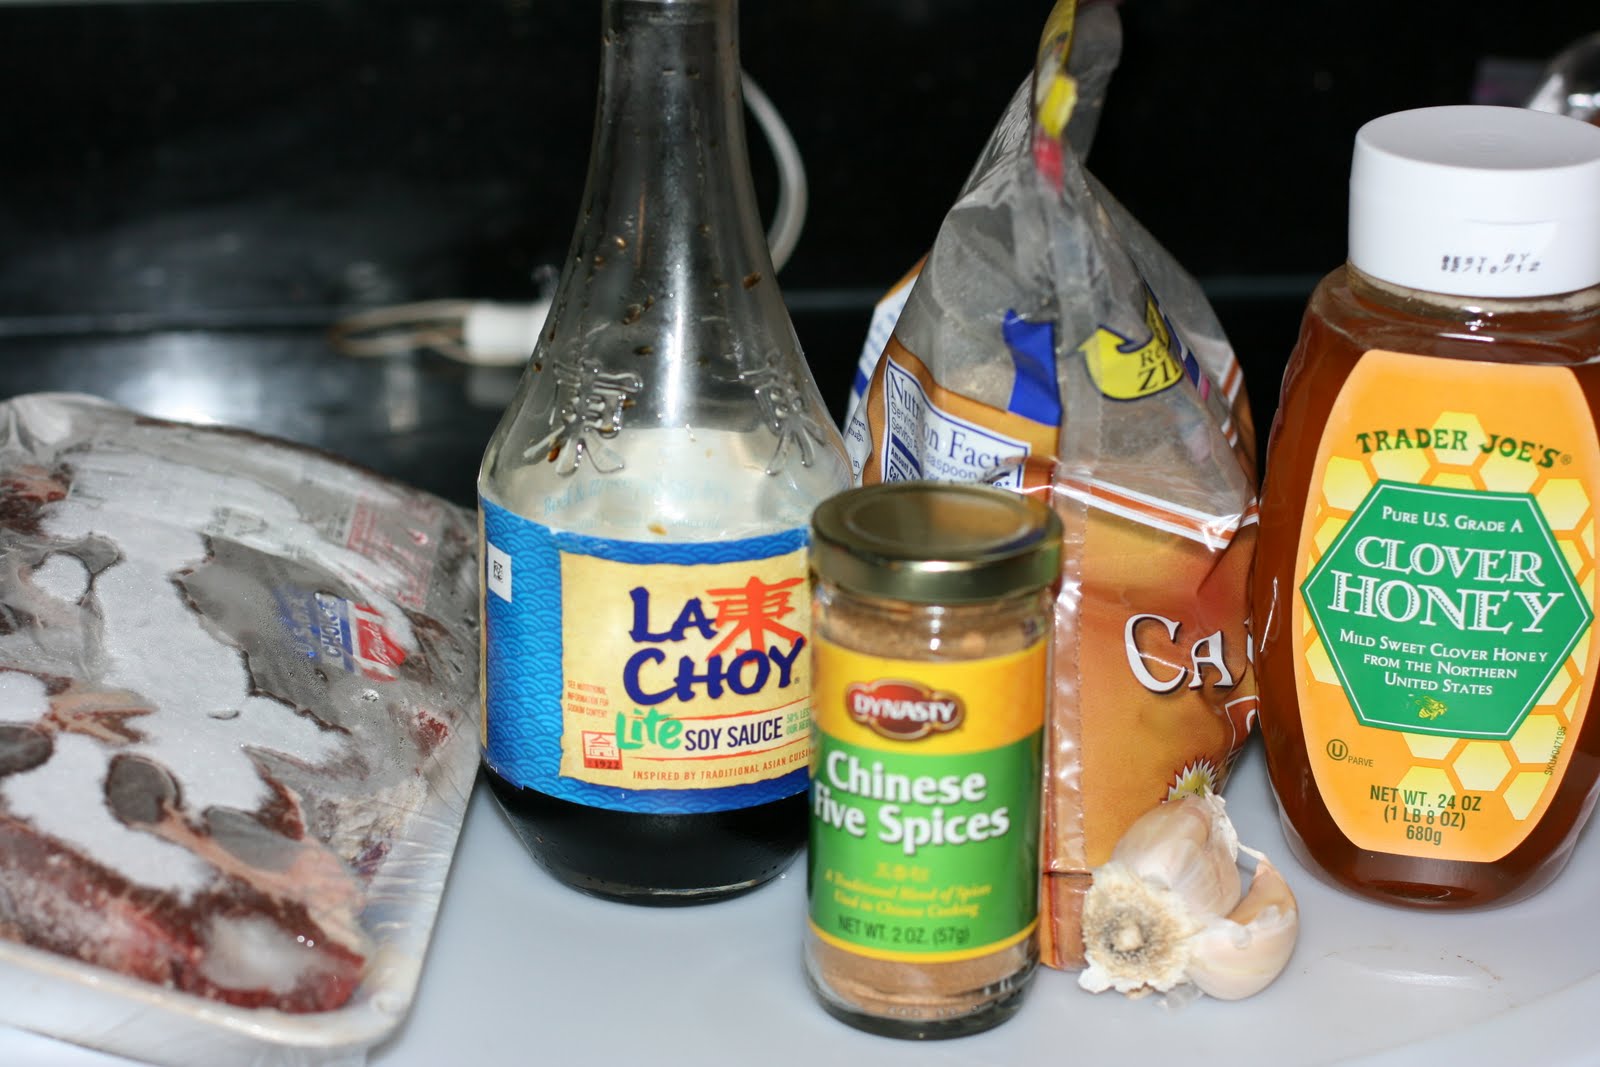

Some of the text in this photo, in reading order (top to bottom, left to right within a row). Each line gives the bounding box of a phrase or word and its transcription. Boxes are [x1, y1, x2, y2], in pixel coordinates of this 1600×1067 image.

[1356, 428, 1468, 454] TRADER
[1423, 512, 1449, 528] U.S.
[1510, 519, 1524, 533] A
[1355, 536, 1545, 587] CLOVER
[629, 586, 718, 642] LA
[1327, 569, 1565, 634] HONEY
[1125, 613, 1253, 694] CA
[1339, 628, 1548, 663] MILD SWEET CLOVER HONEY
[623, 637, 805, 706] CHOY
[1363, 653, 1517, 680] FROM THE NORTHERN
[1384, 671, 1493, 696] UNITED STATES
[853, 692, 955, 723] DYNASTY
[615, 707, 683, 750] Lite
[685, 728, 723, 751] SOY
[727, 716, 783, 748] SAUCE
[594, 760, 620, 770] 1922
[633, 771, 680, 781] INSPIRED
[684, 771, 696, 780] BY
[701, 765, 759, 780] TRADITIONAL
[763, 758, 786, 770] ASIAN
[827, 749, 987, 803] Chinese
[1348, 755, 1374, 768] PARVE
[1370, 785, 1481, 812] NET WT. 24 OZ
[814, 779, 1010, 854] Five Spices
[1384, 805, 1466, 831] (1 LB 8 OZ)
[1406, 825, 1442, 846] 680g
[838, 914, 861, 935] NET
[892, 927, 901, 943] 2
